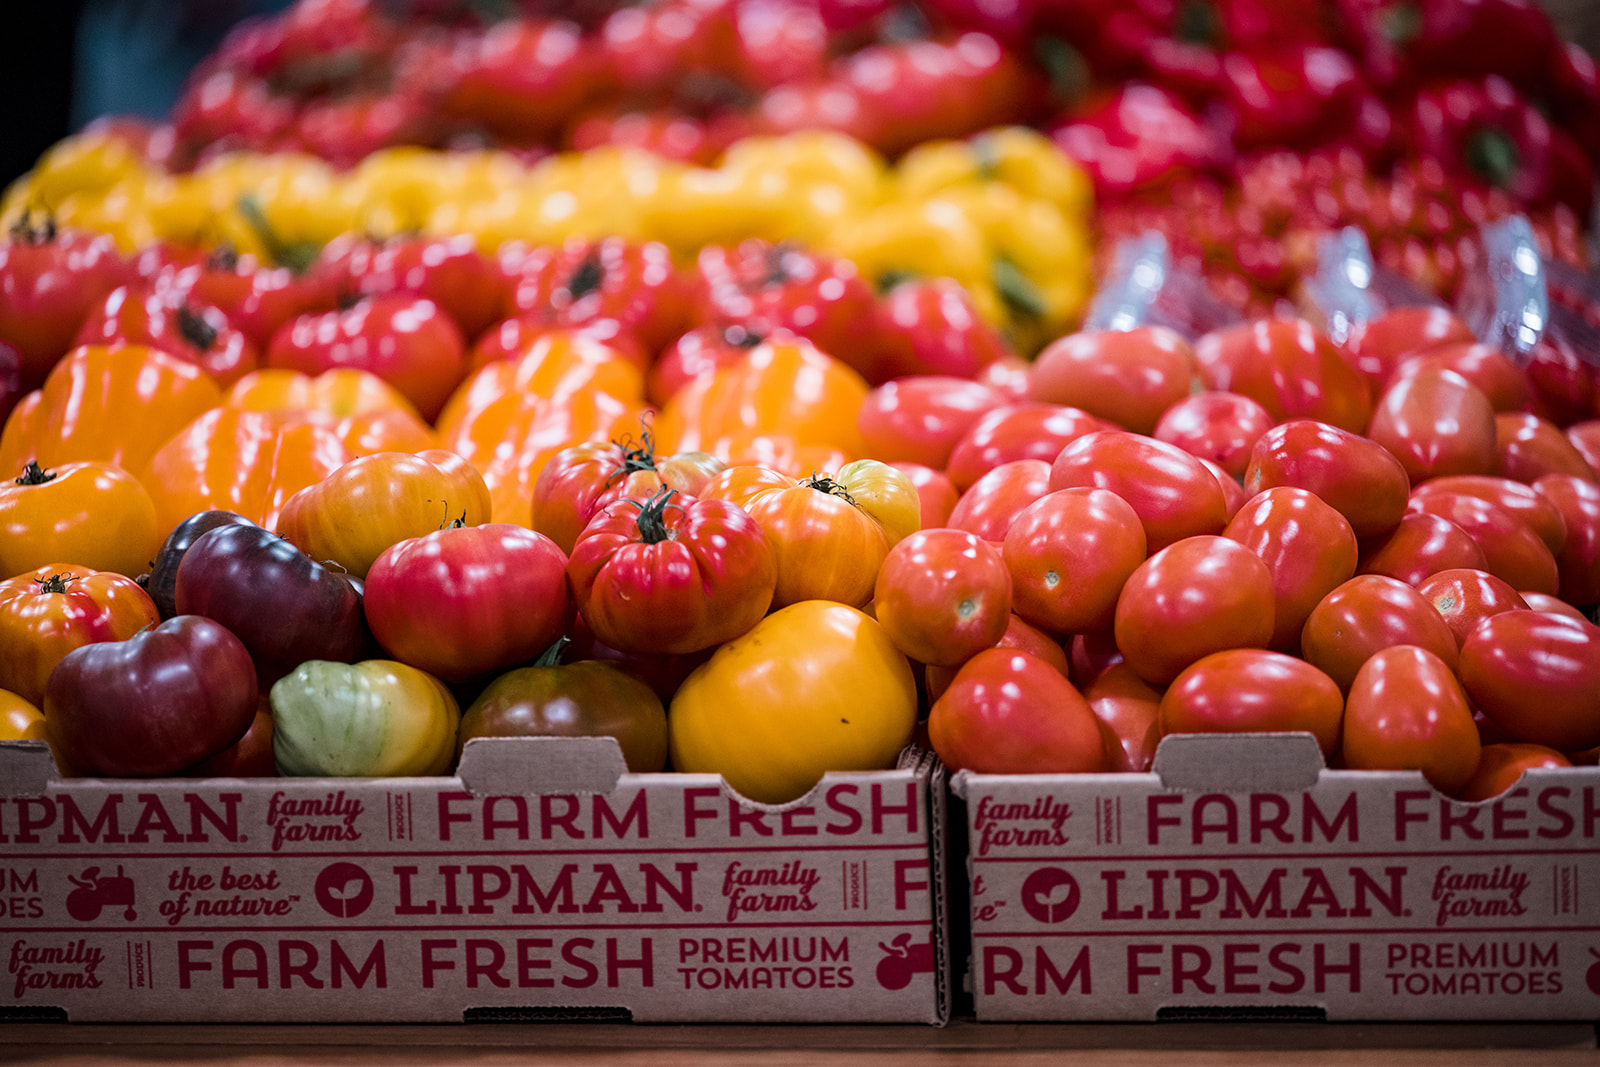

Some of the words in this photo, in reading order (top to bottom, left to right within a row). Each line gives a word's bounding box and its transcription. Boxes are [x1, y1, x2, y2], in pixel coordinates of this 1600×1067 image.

[267, 790, 365, 826] family
[438, 788, 649, 841] FARM
[974, 794, 1073, 830] family
[1147, 792, 1359, 845] FARM
[272, 817, 362, 851] farms
[979, 822, 1070, 856] farms
[168, 866, 215, 891] the
[220, 866, 281, 891] best
[393, 862, 700, 915] LIPMAN
[722, 860, 821, 896] family
[1101, 866, 1409, 920] LIPMAN
[1432, 864, 1530, 900] family
[159, 891, 192, 926] of
[727, 887, 818, 923] farms
[1436, 892, 1528, 928] farms
[8, 939, 104, 974] family
[134, 942, 145, 988] PRODUCE
[178, 939, 388, 989] FARM
[421, 938, 654, 989] FRESH
[679, 937, 849, 964] PREMIUM
[1387, 942, 1558, 969] PREMIUM
[14, 965, 103, 998] farms
[677, 966, 854, 990] TOMATOES
[1127, 943, 1361, 995] FRESH
[1385, 971, 1562, 996] TOMATOES
